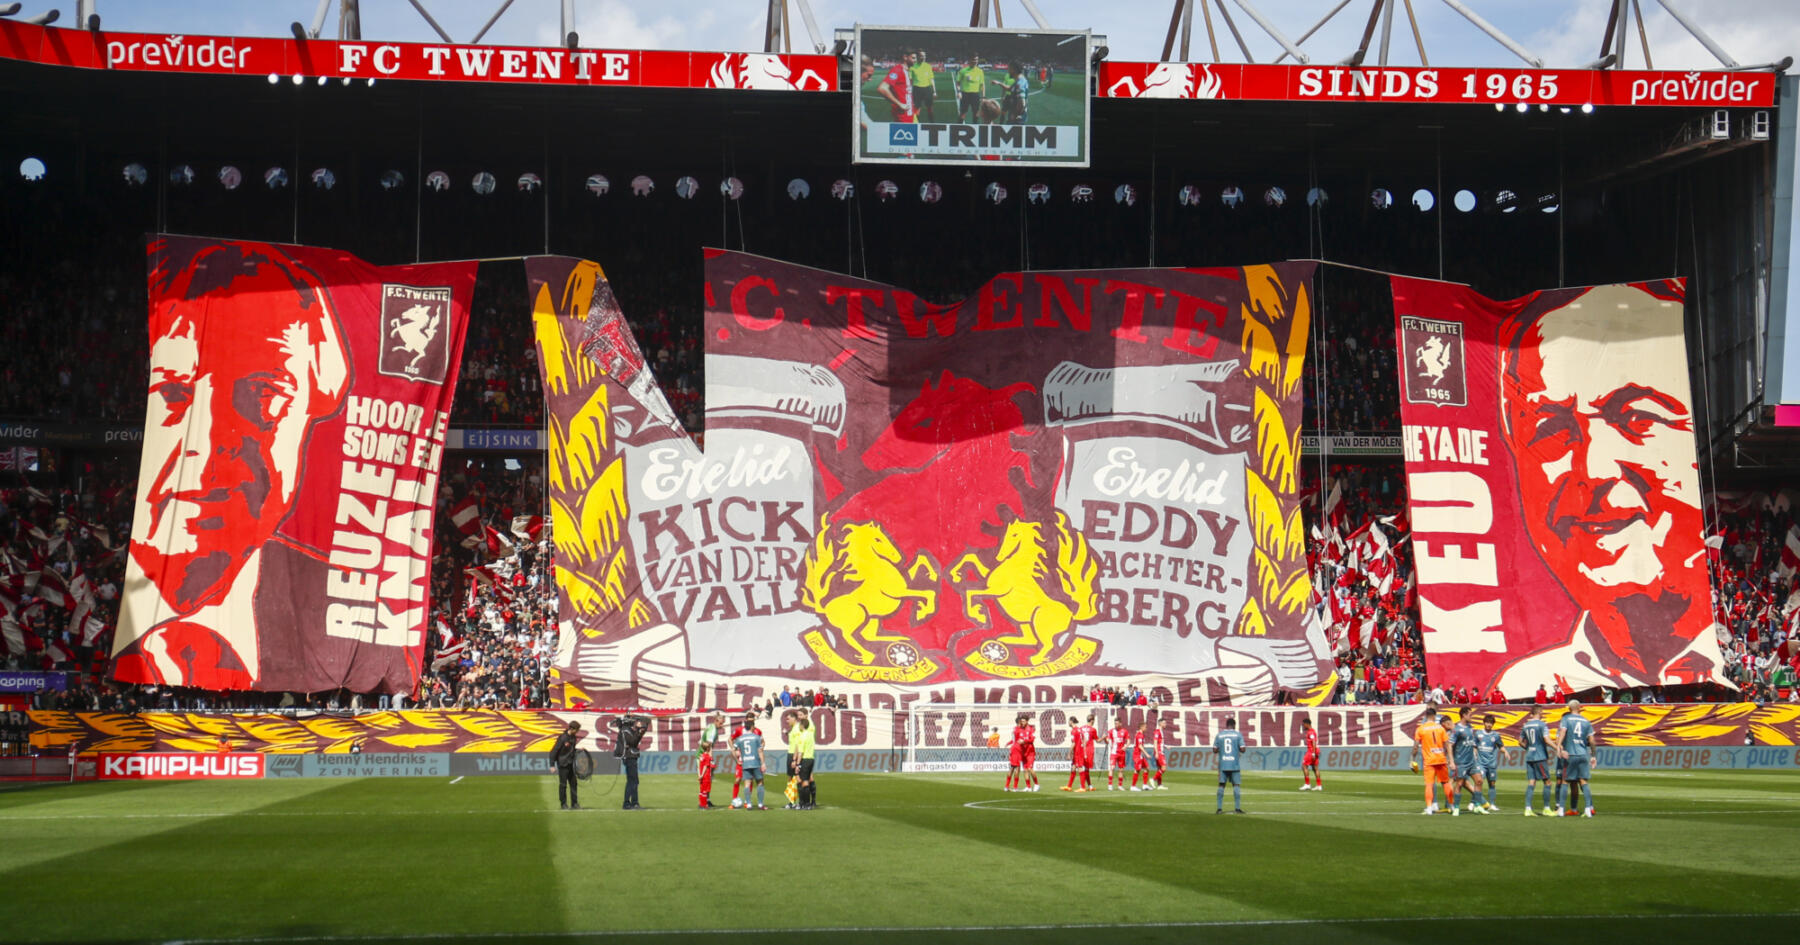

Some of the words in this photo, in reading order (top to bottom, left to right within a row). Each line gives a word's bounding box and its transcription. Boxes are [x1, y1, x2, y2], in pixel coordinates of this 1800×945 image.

[107, 36, 251, 69] previder
[339, 45, 400, 74] FC
[423, 47, 630, 81] TWENTE
[1299, 68, 1438, 98] SINDS
[1463, 74, 1559, 99] 1965
[1632, 72, 1759, 104] previder
[921, 123, 1057, 149] TRIMM
[825, 271, 1229, 359] TWENTE
[1424, 388, 1451, 400] 1965
[345, 395, 425, 435] HOOR
[342, 425, 410, 466] SOMS
[1333, 437, 1351, 447] VAN
[1353, 437, 1370, 447] DER
[1372, 437, 1402, 448] MOLEN
[641, 444, 792, 501] Erelid
[1093, 446, 1229, 505] Erelid
[638, 496, 814, 564] KICK
[1082, 499, 1241, 557] EDDY
[325, 460, 396, 644] REUZE
[374, 472, 438, 648] KNAL
[1408, 471, 1508, 654] KEU
[645, 549, 723, 592] VAN
[730, 546, 801, 582] DER
[1101, 550, 1243, 594] ACHTER-
[657, 581, 801, 623] VALL
[1101, 588, 1231, 639] BERG
[685, 680, 764, 713] UIT
[894, 710, 990, 747] DEZE
[1016, 708, 1067, 746] C
[1432, 731, 1437, 745] 1
[1525, 728, 1536, 745] 10
[1573, 721, 1582, 738] 4
[316, 753, 360, 766] Henny
[364, 753, 426, 765] Hendriks
[743, 740, 752, 755] 5
[1168, 750, 1219, 772] energ
[1223, 738, 1232, 754] 6
[1327, 749, 1400, 770] energie
[1640, 748, 1711, 770] energie
[1747, 748, 1789, 769] pure
[104, 756, 259, 776] KAMPHUIS
[319, 767, 438, 777] ZONWERING
[637, 754, 672, 773] ure
